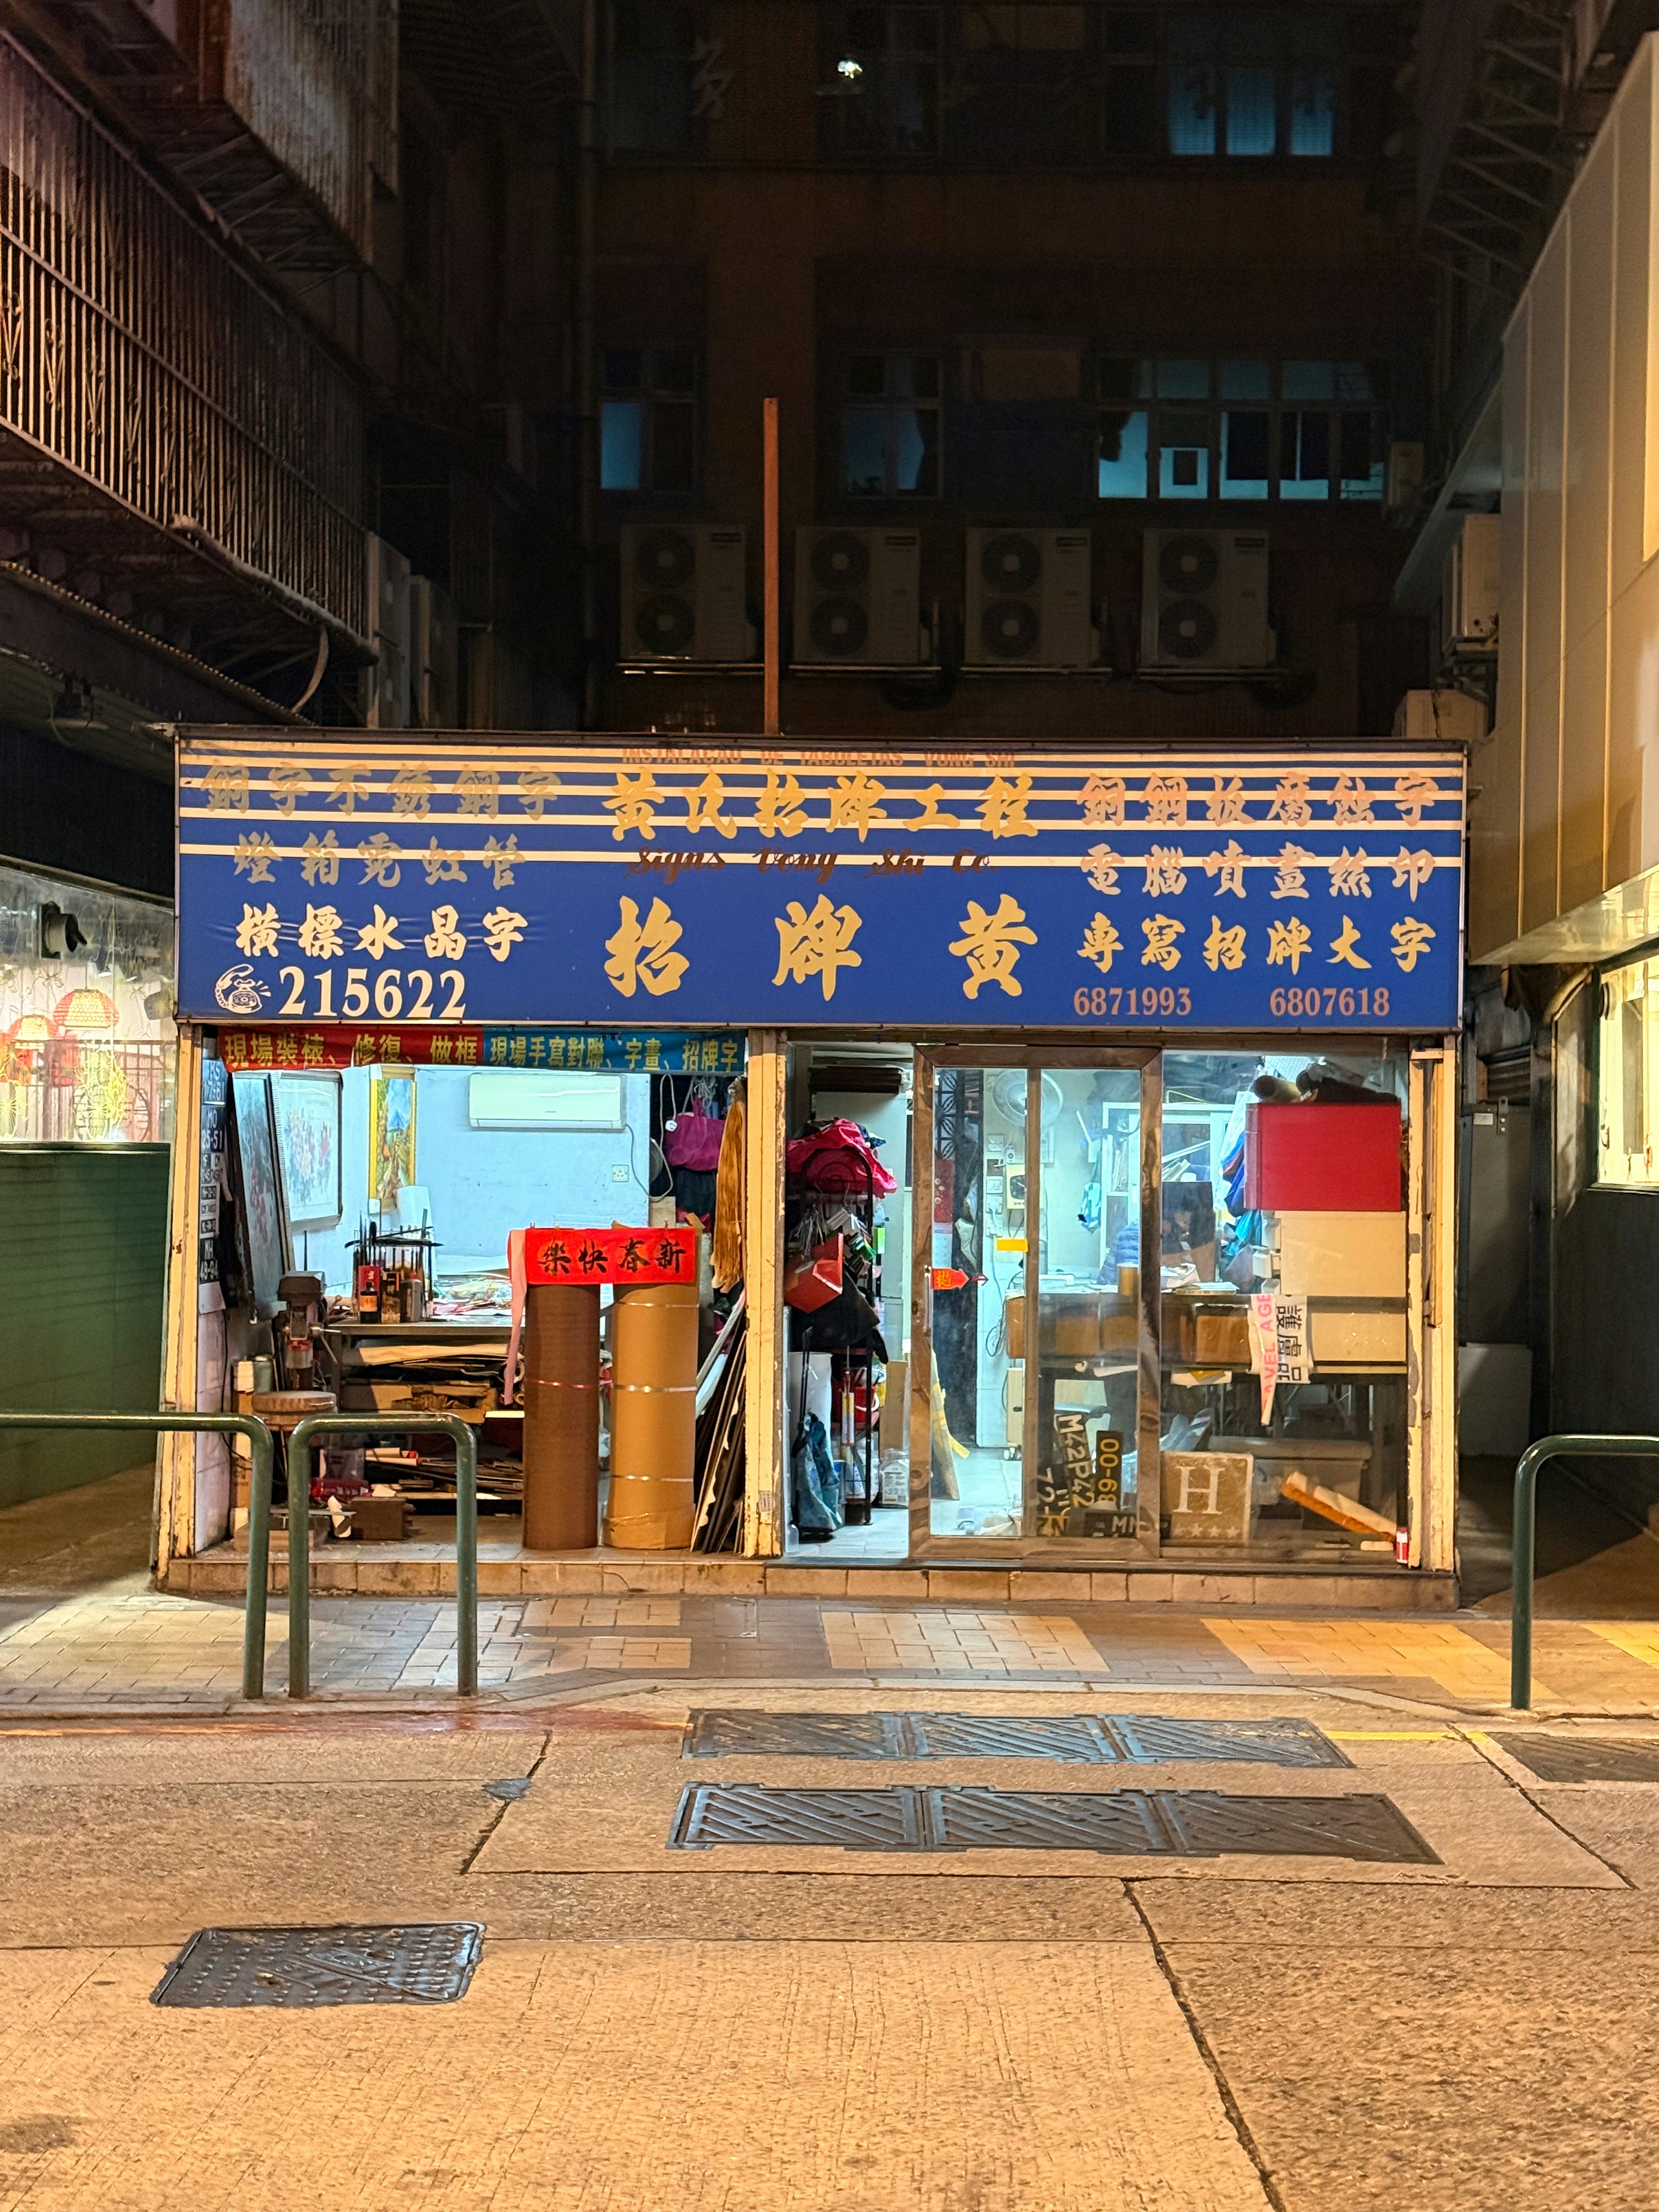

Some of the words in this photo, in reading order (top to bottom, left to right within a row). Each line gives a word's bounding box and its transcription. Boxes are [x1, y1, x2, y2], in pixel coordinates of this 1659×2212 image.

[760, 750, 783, 765] DE
[924, 752, 973, 767] VONG
[985, 752, 1014, 768] SHI
[234, 830, 526, 890] 燈箱霓虹管
[624, 847, 725, 884] Signs
[752, 847, 837, 884] Vong
[867, 848, 926, 878] Shi
[1080, 839, 1436, 902] 電腦噴畫絲印
[278, 966, 467, 1019] 215622
[1073, 987, 1192, 1016] 6871993
[1269, 987, 1391, 1017] 6807618
[1171, 1466, 1226, 1515] H
